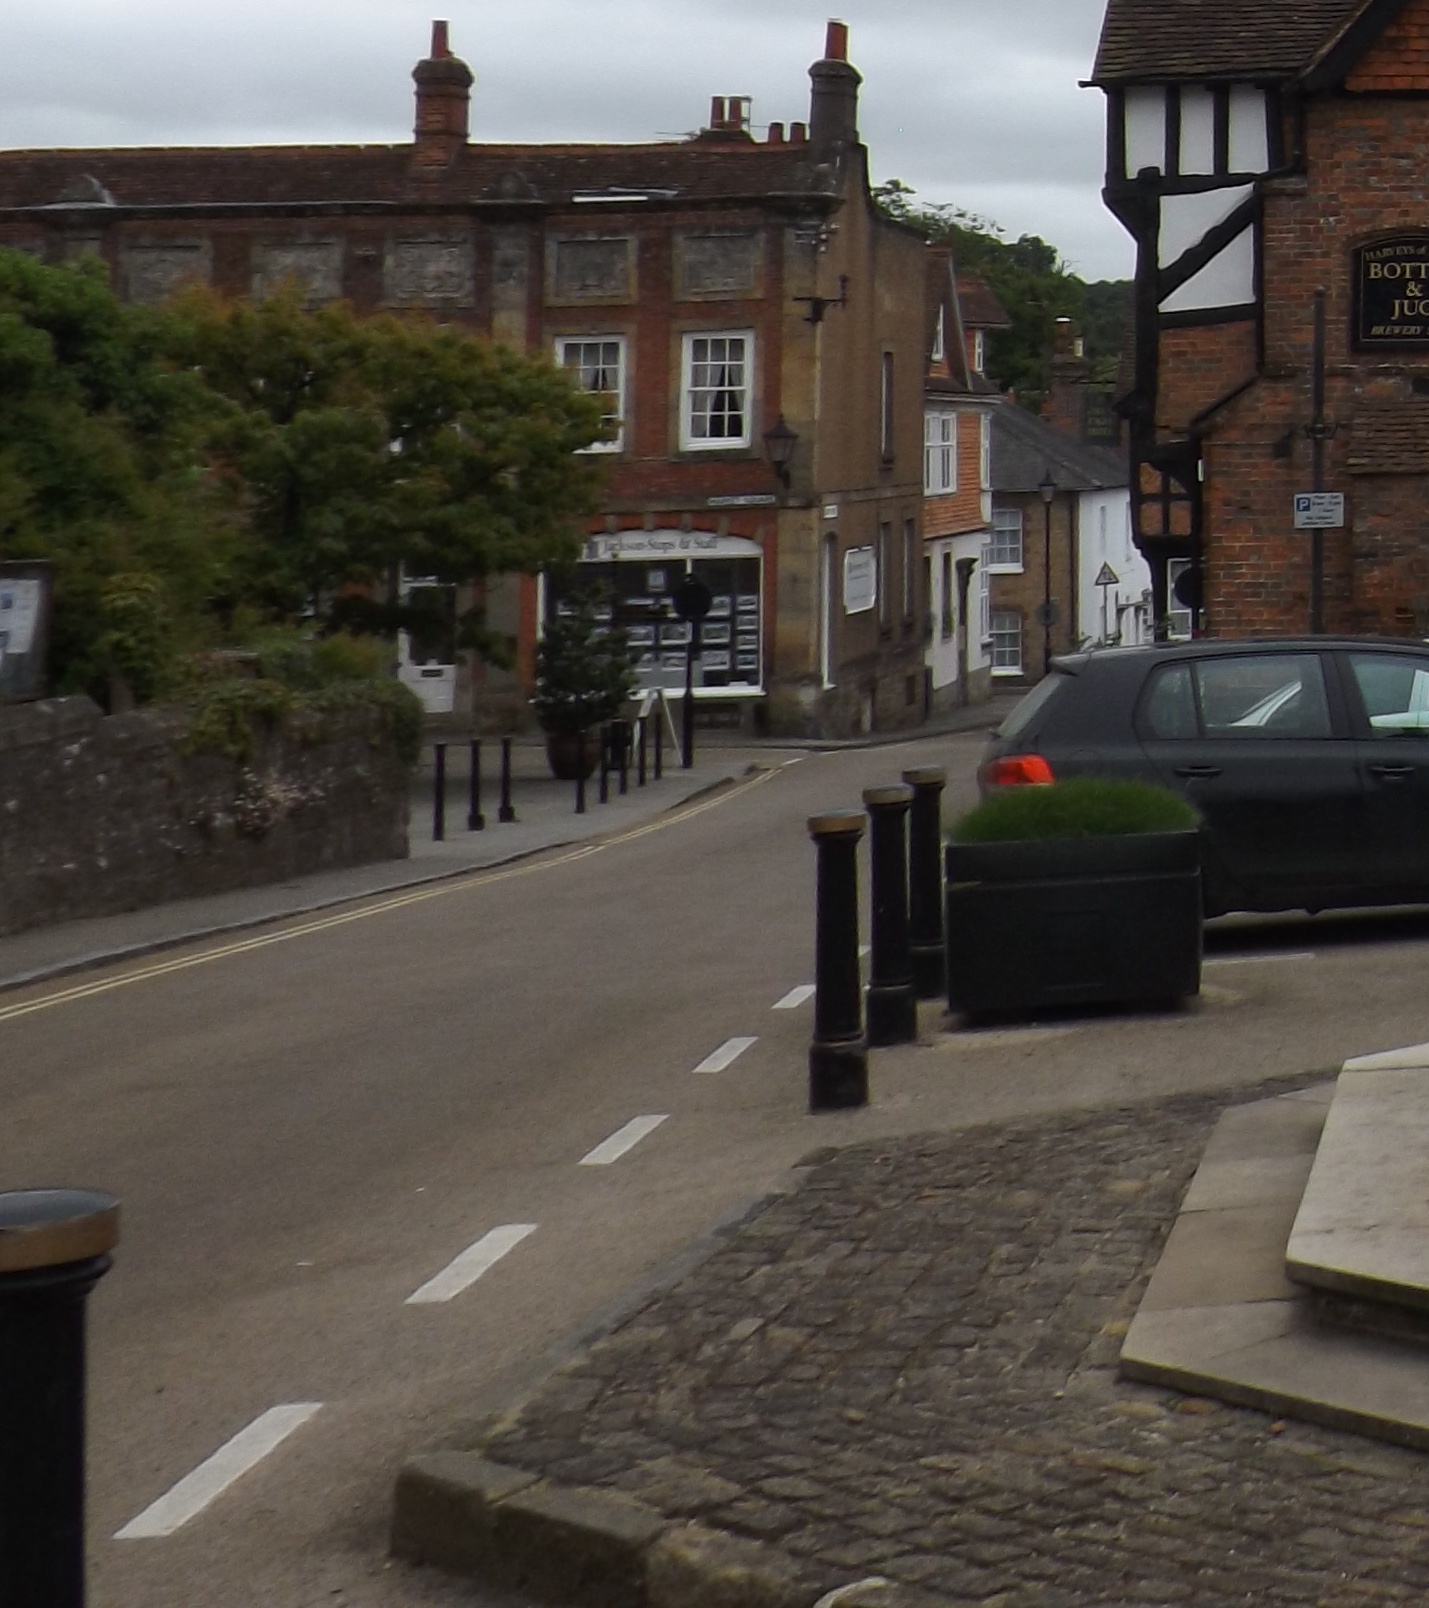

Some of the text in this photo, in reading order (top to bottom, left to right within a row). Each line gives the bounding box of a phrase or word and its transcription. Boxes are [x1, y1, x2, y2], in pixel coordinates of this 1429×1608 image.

[1364, 245, 1415, 260] HARVEYS
[1406, 281, 1423, 297] &
[1371, 325, 1422, 335] BREWERY
